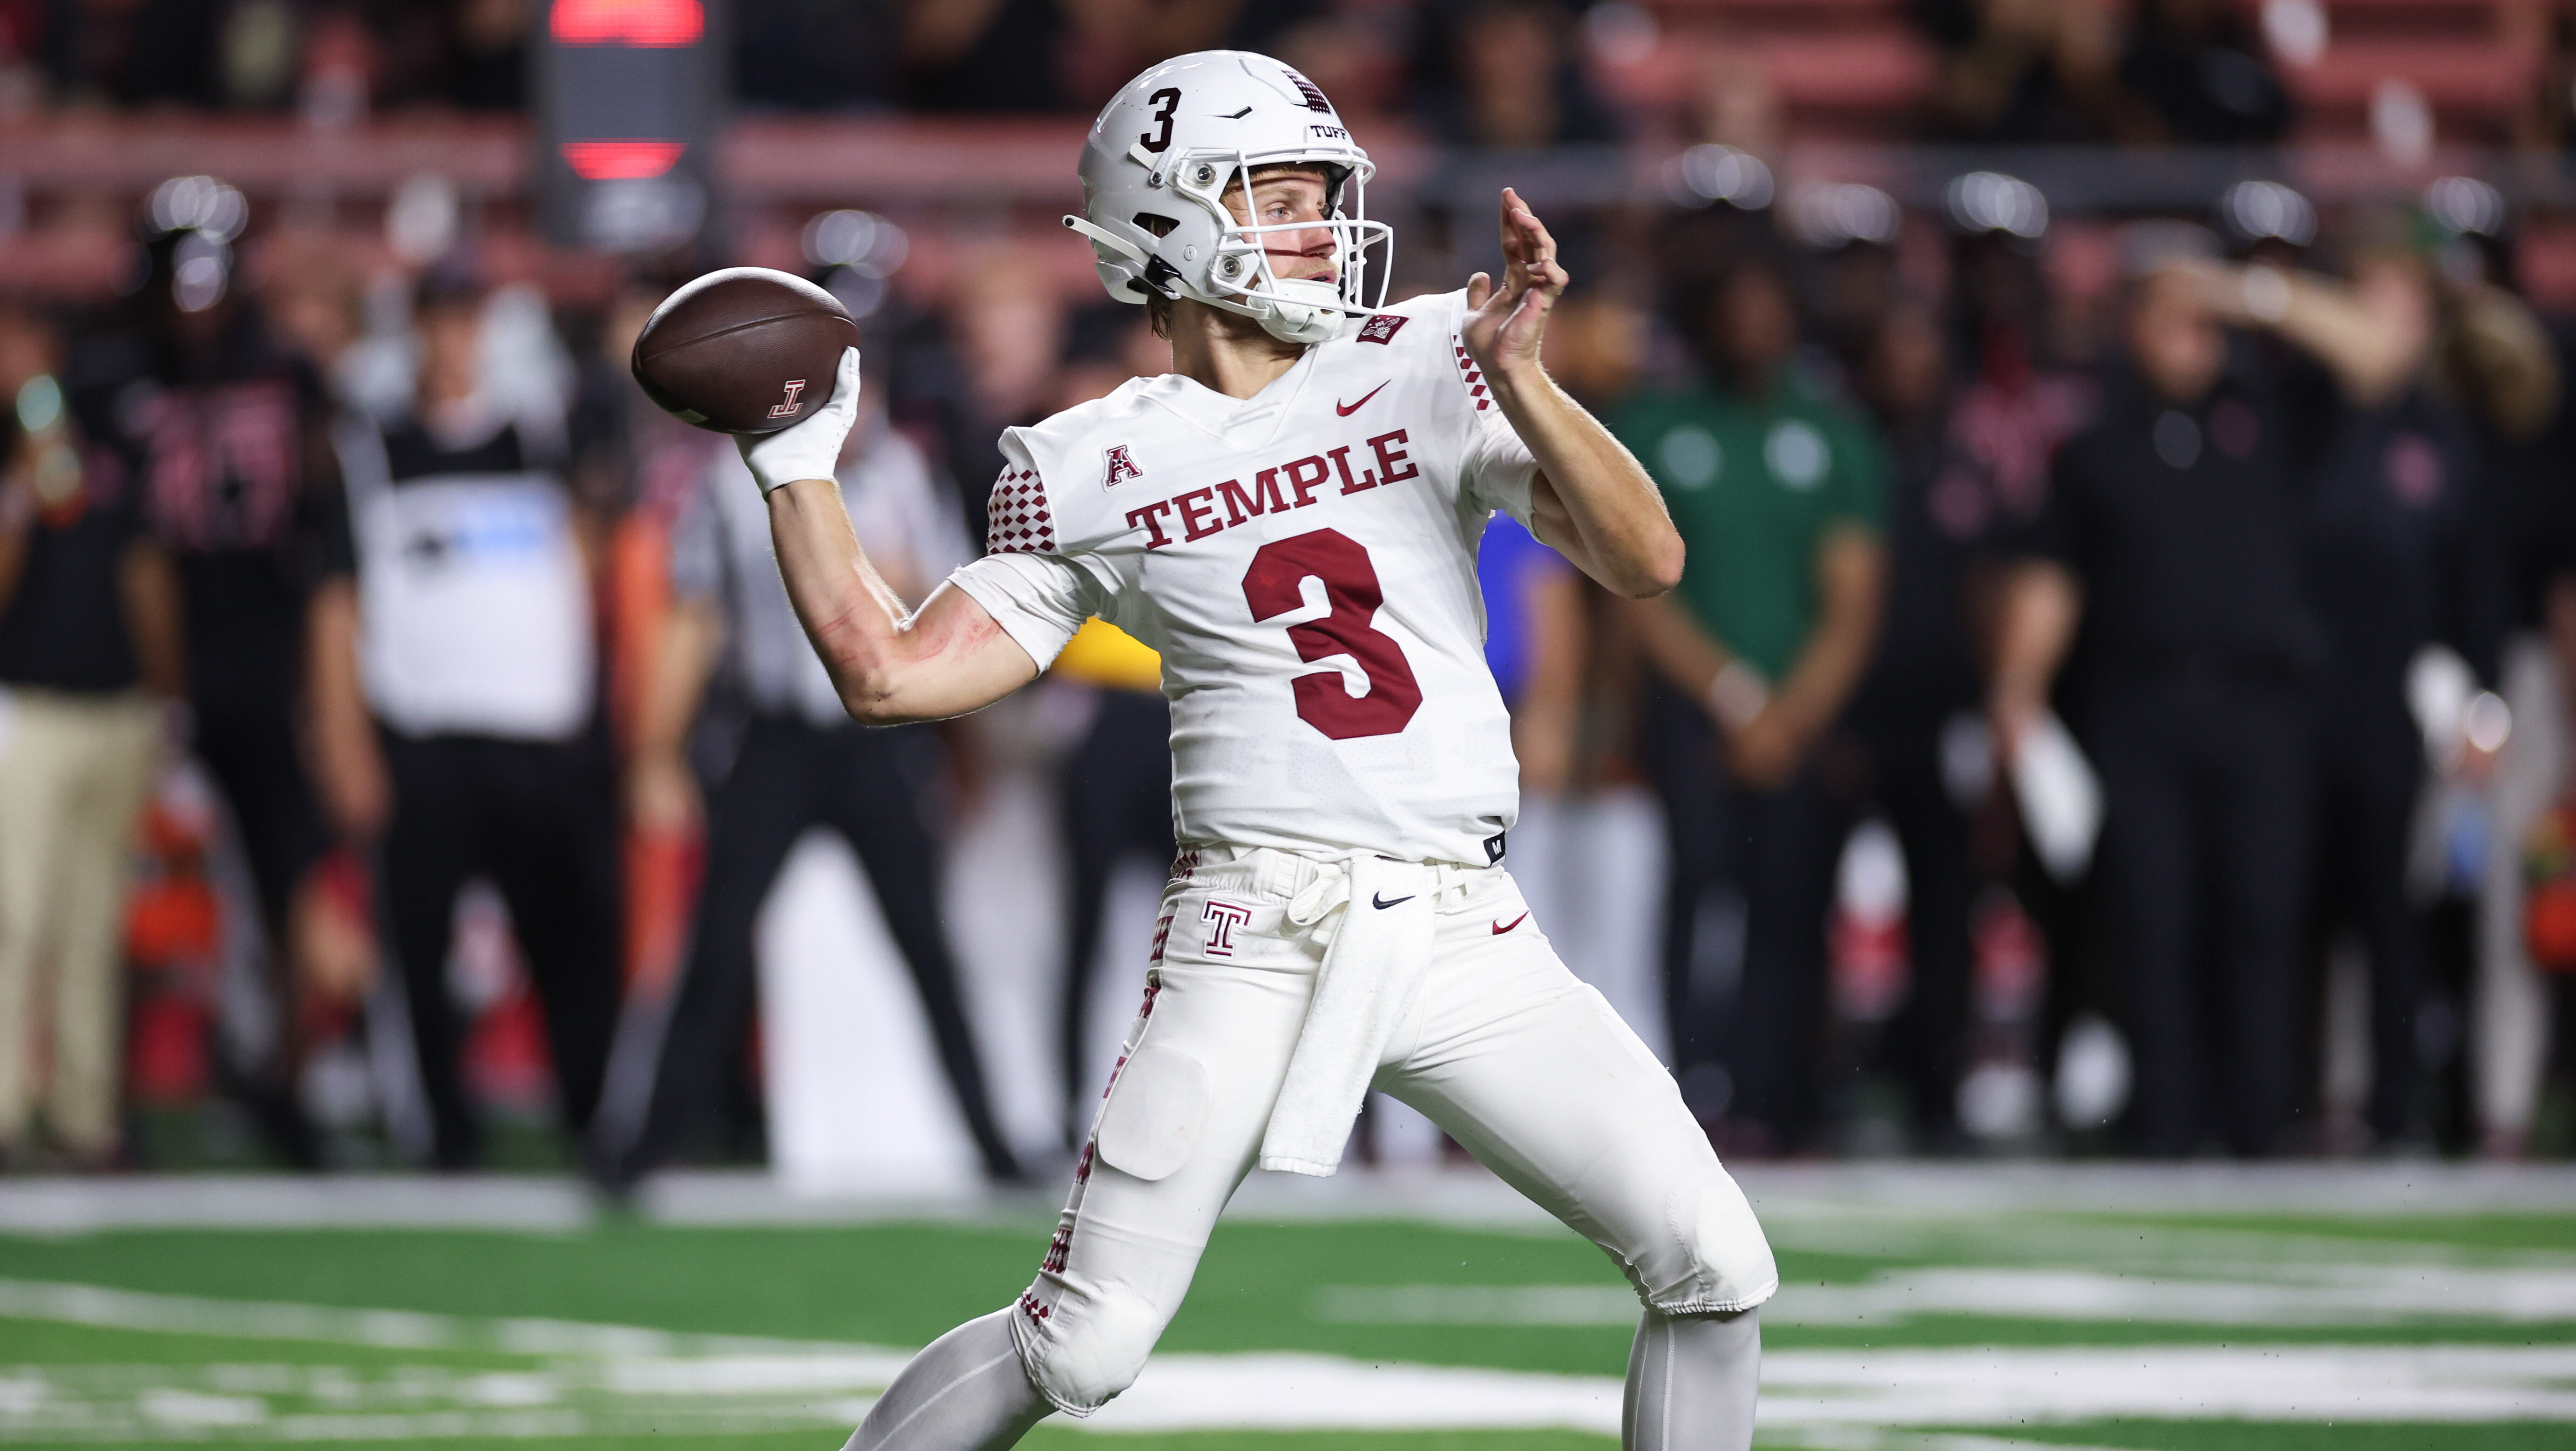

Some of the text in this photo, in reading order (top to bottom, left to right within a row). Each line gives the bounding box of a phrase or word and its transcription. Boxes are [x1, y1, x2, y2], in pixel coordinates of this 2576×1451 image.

[1140, 87, 1182, 153] 3
[1309, 125, 1346, 140] TUFF
[1106, 445, 1143, 488] A
[1125, 428, 1419, 550] TEMPLE
[1241, 527, 1423, 740] 3
[1491, 839, 1502, 855] M
[1203, 900, 1252, 957] T
